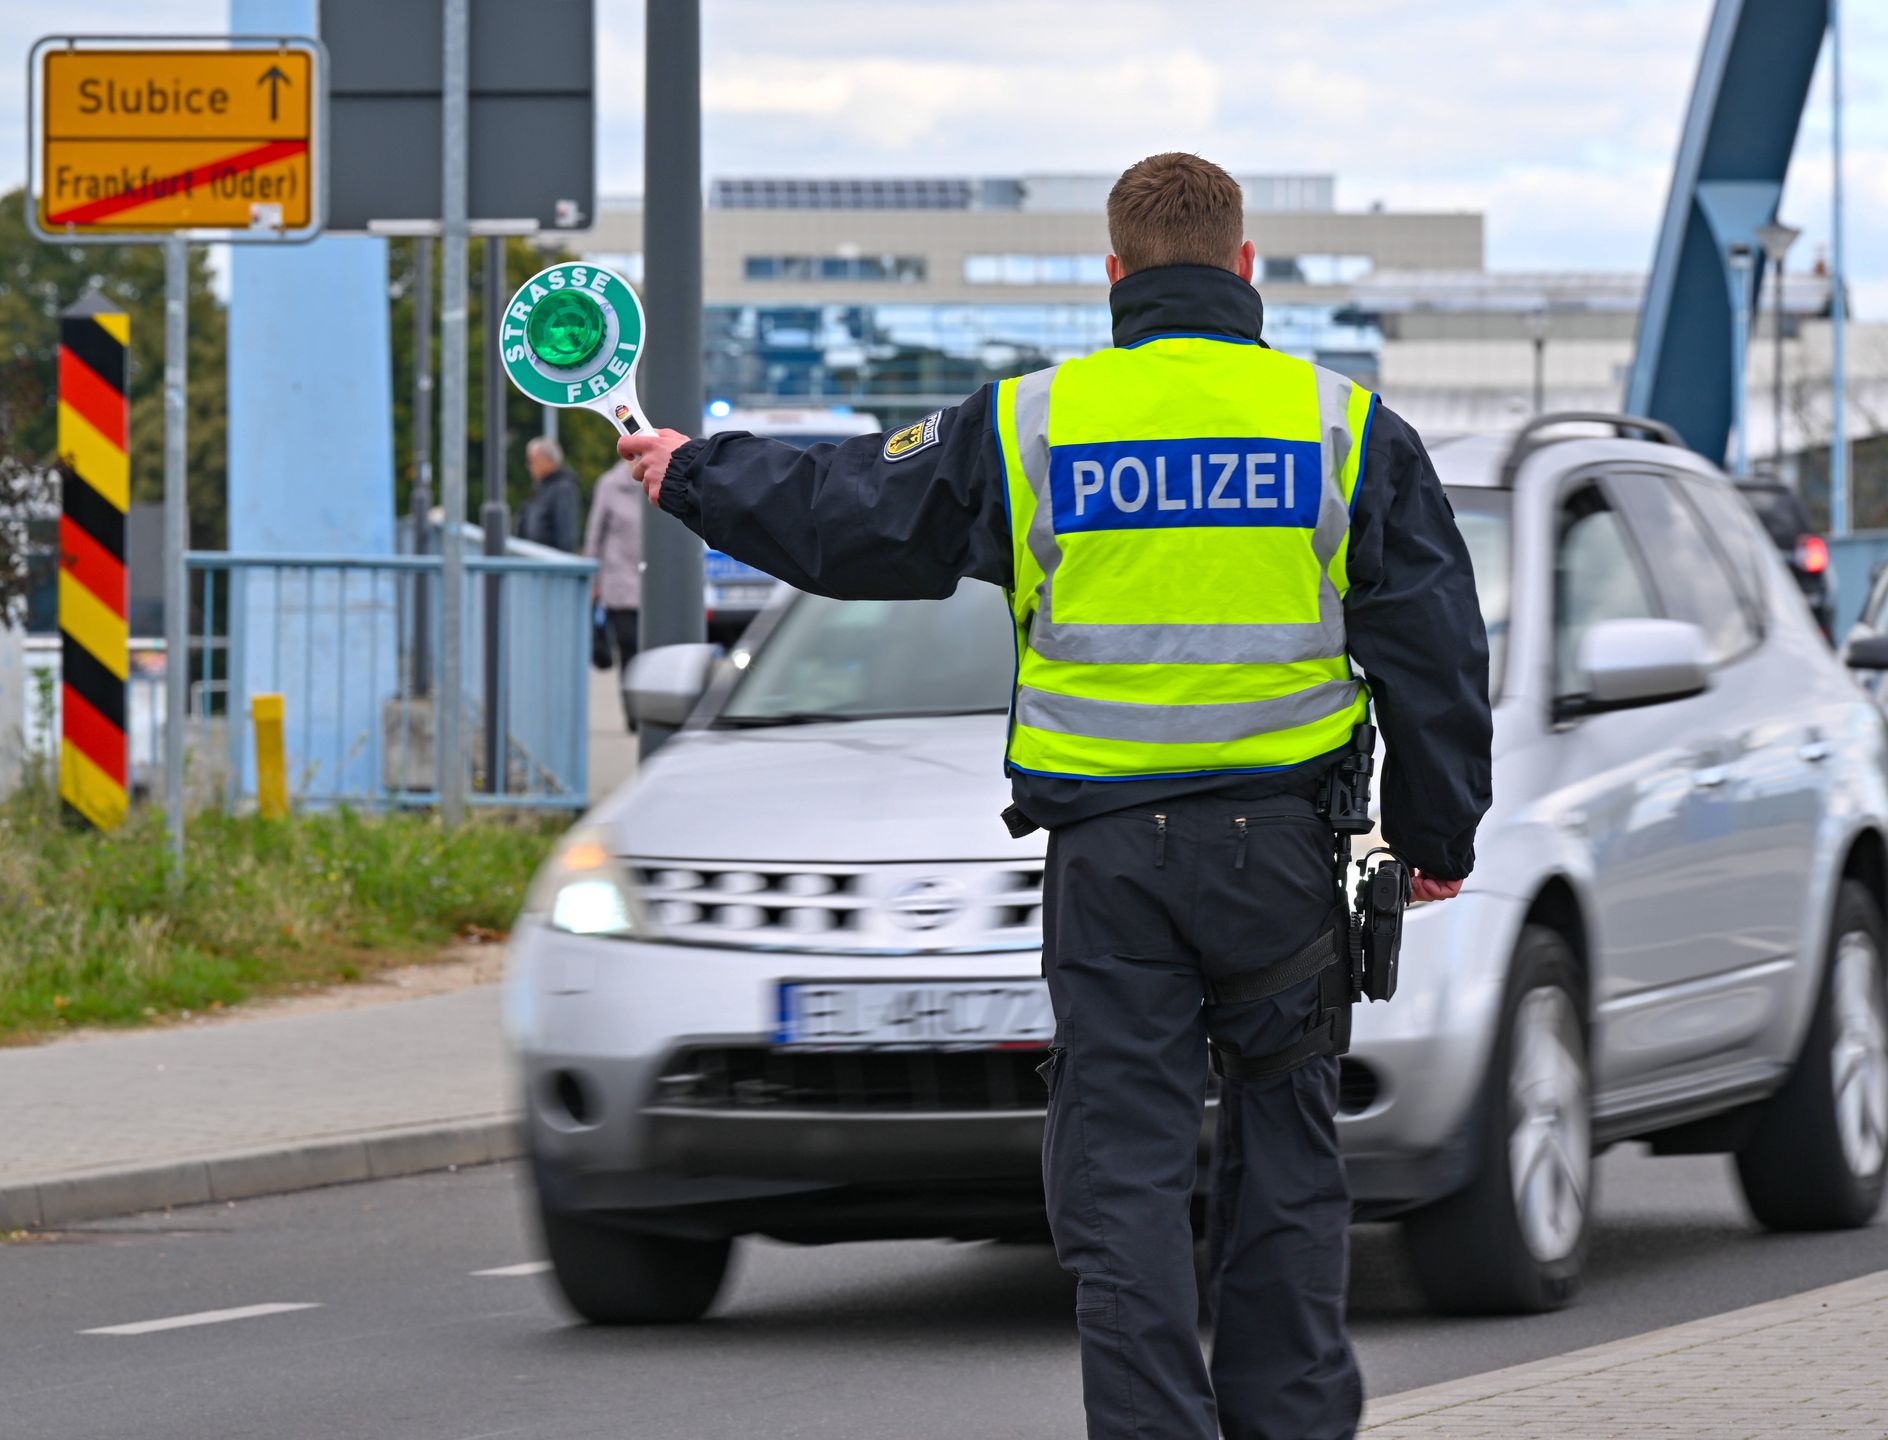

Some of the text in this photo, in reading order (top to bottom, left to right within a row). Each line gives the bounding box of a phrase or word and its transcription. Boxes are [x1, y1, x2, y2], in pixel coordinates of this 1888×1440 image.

[78, 78, 229, 115] Slubice
[56, 164, 298, 200] Frankfurt (Oder)
[504, 267, 611, 363] STRASSE
[566, 342, 637, 403] FREI
[1072, 453, 1295, 516] POLIZEI
